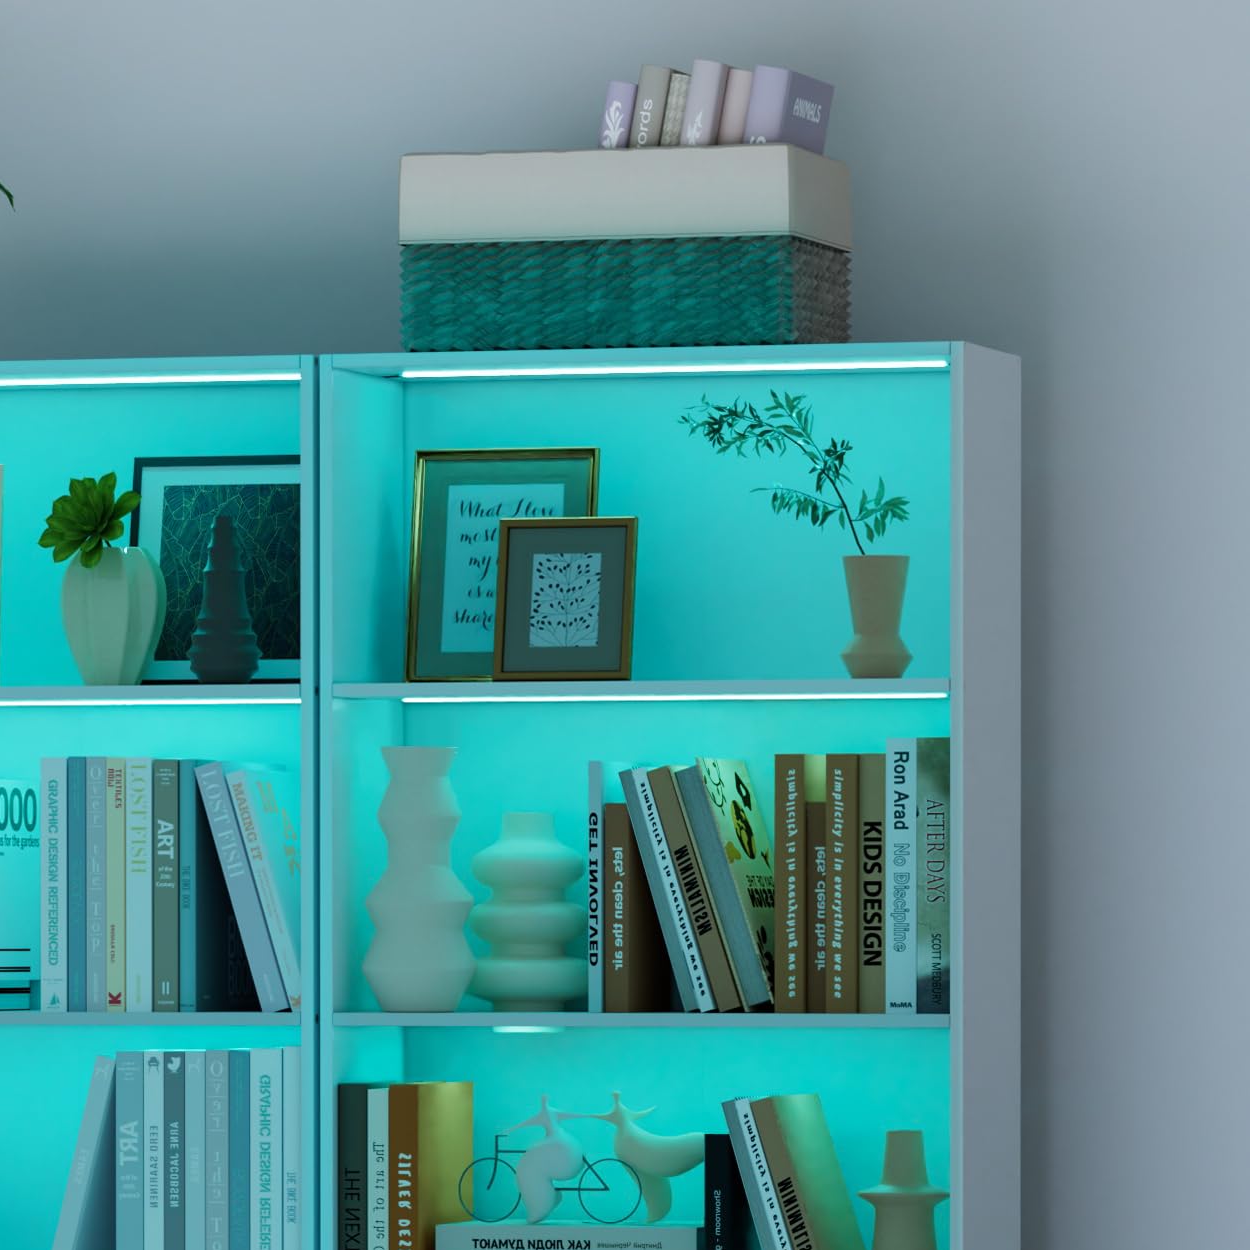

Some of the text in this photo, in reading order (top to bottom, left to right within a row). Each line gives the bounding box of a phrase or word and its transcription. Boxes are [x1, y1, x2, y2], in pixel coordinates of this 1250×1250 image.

[637, 99, 653, 148] ords
[792, 97, 822, 124] ANIMALS
[460, 500, 502, 518] What
[460, 528, 497, 544] most
[468, 556, 490, 581] my
[157, 820, 174, 860] ART
[202, 769, 244, 878] LOST FISH
[891, 751, 910, 952] Ron Arad No Discipline
[48, 779, 59, 966] GRAPHIC DESIGN REFERENCED
[833, 768, 843, 998] simplicity is in everything we see
[863, 821, 882, 966] KIDS DESIGN
[926, 799, 945, 1004] AFTER DAYS SCOTT MEDBURY
